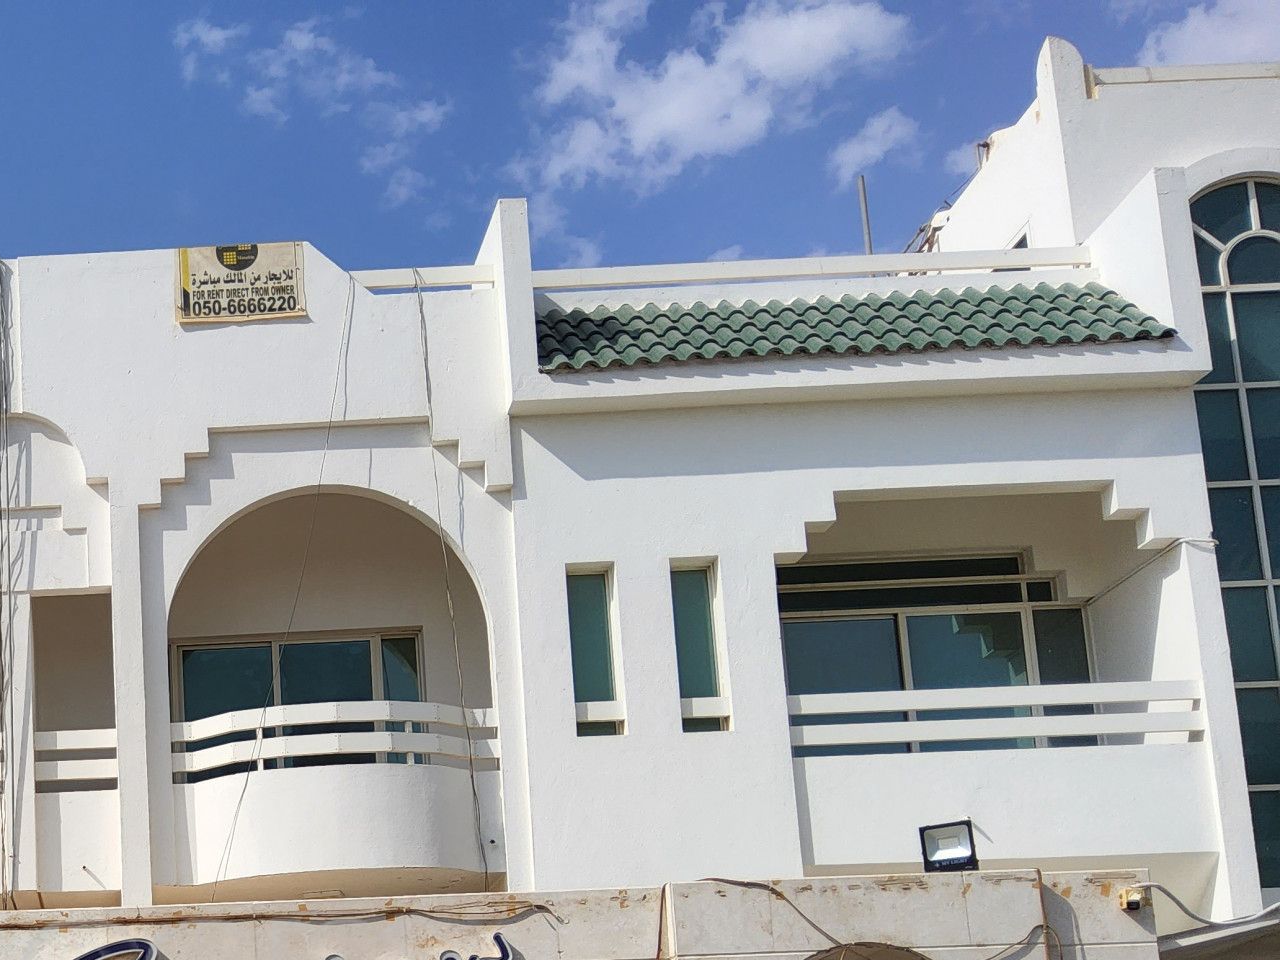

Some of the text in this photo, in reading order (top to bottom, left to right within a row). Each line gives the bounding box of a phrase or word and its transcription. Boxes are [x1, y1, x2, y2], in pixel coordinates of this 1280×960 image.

[191, 270, 220, 289] مباشرة
[223, 271, 247, 284] المالك
[249, 271, 261, 286] من
[192, 284, 295, 301] FOR RENT DIRECT FROM OWNER
[192, 295, 296, 316] 050-6666220
